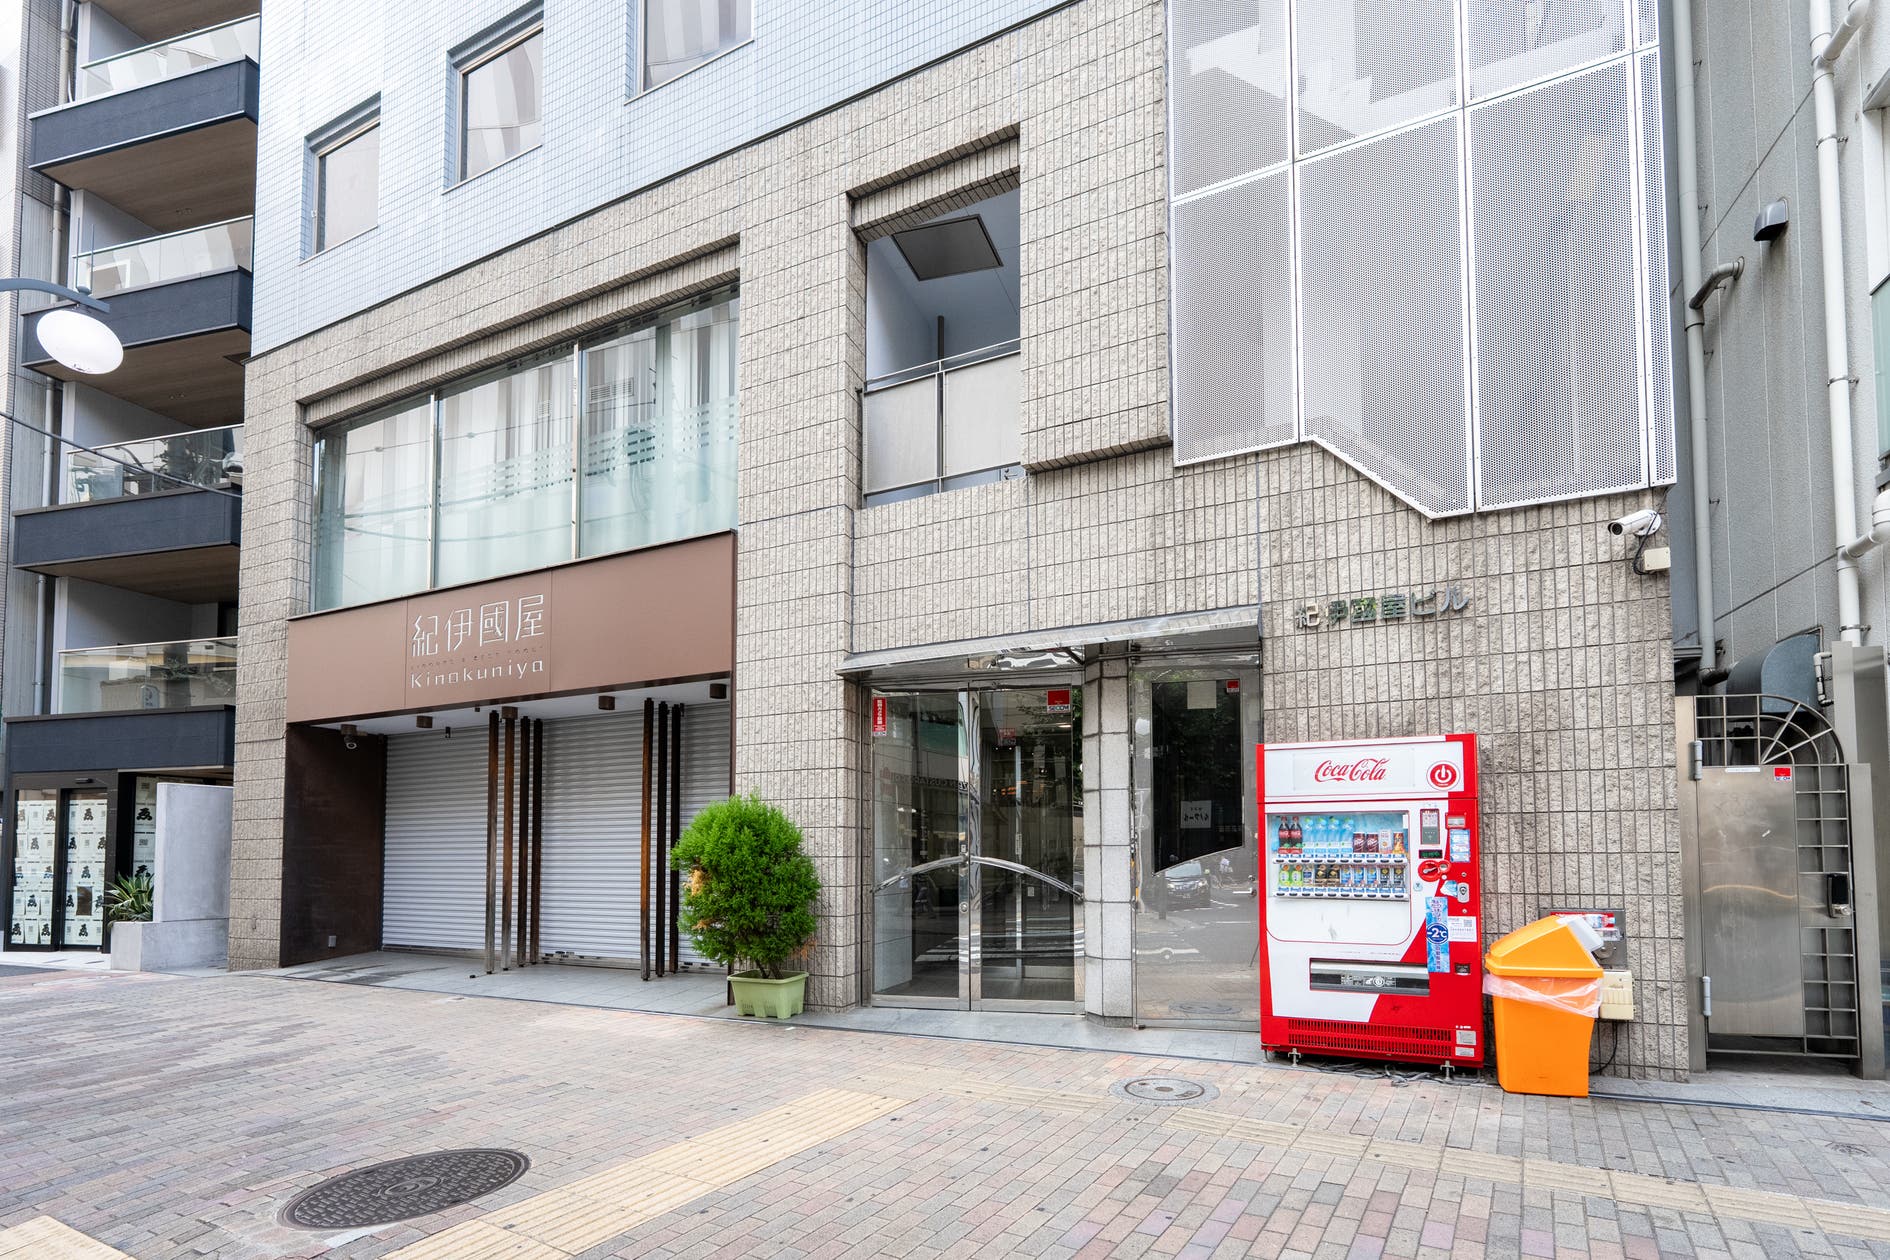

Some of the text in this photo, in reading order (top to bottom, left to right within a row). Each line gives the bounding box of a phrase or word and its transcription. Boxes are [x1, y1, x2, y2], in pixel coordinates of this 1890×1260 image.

[412, 594, 545, 657] 紀伊國屋
[411, 660, 544, 689] Kinokuniya
[1315, 757, 1391, 783] Coca-Cola
